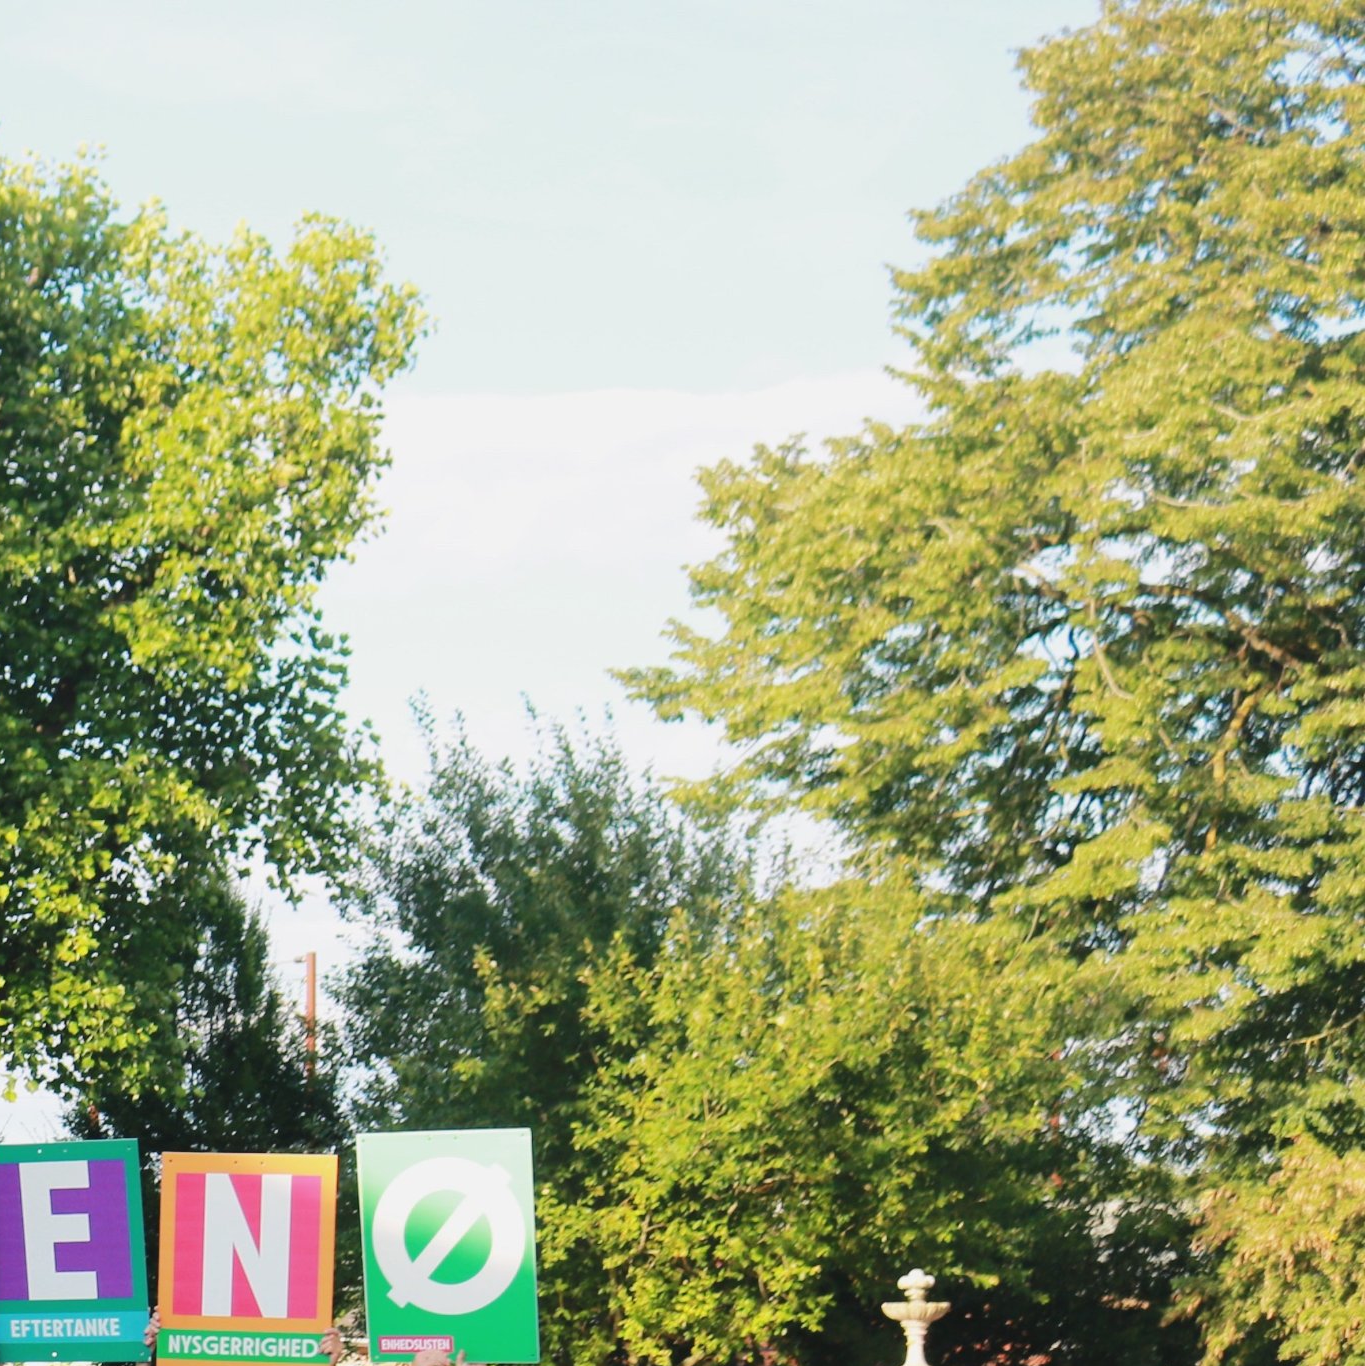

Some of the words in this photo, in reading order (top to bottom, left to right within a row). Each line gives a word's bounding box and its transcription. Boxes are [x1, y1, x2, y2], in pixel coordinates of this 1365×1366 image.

[19, 1161, 98, 1300] E
[201, 1172, 292, 1318] N
[372, 1156, 527, 1316] Ø
[11, 1318, 120, 1337] EFTERTANKE
[168, 1334, 320, 1358] NYSGERRIGHED
[381, 1338, 451, 1352] ENHEDSLISTEN
